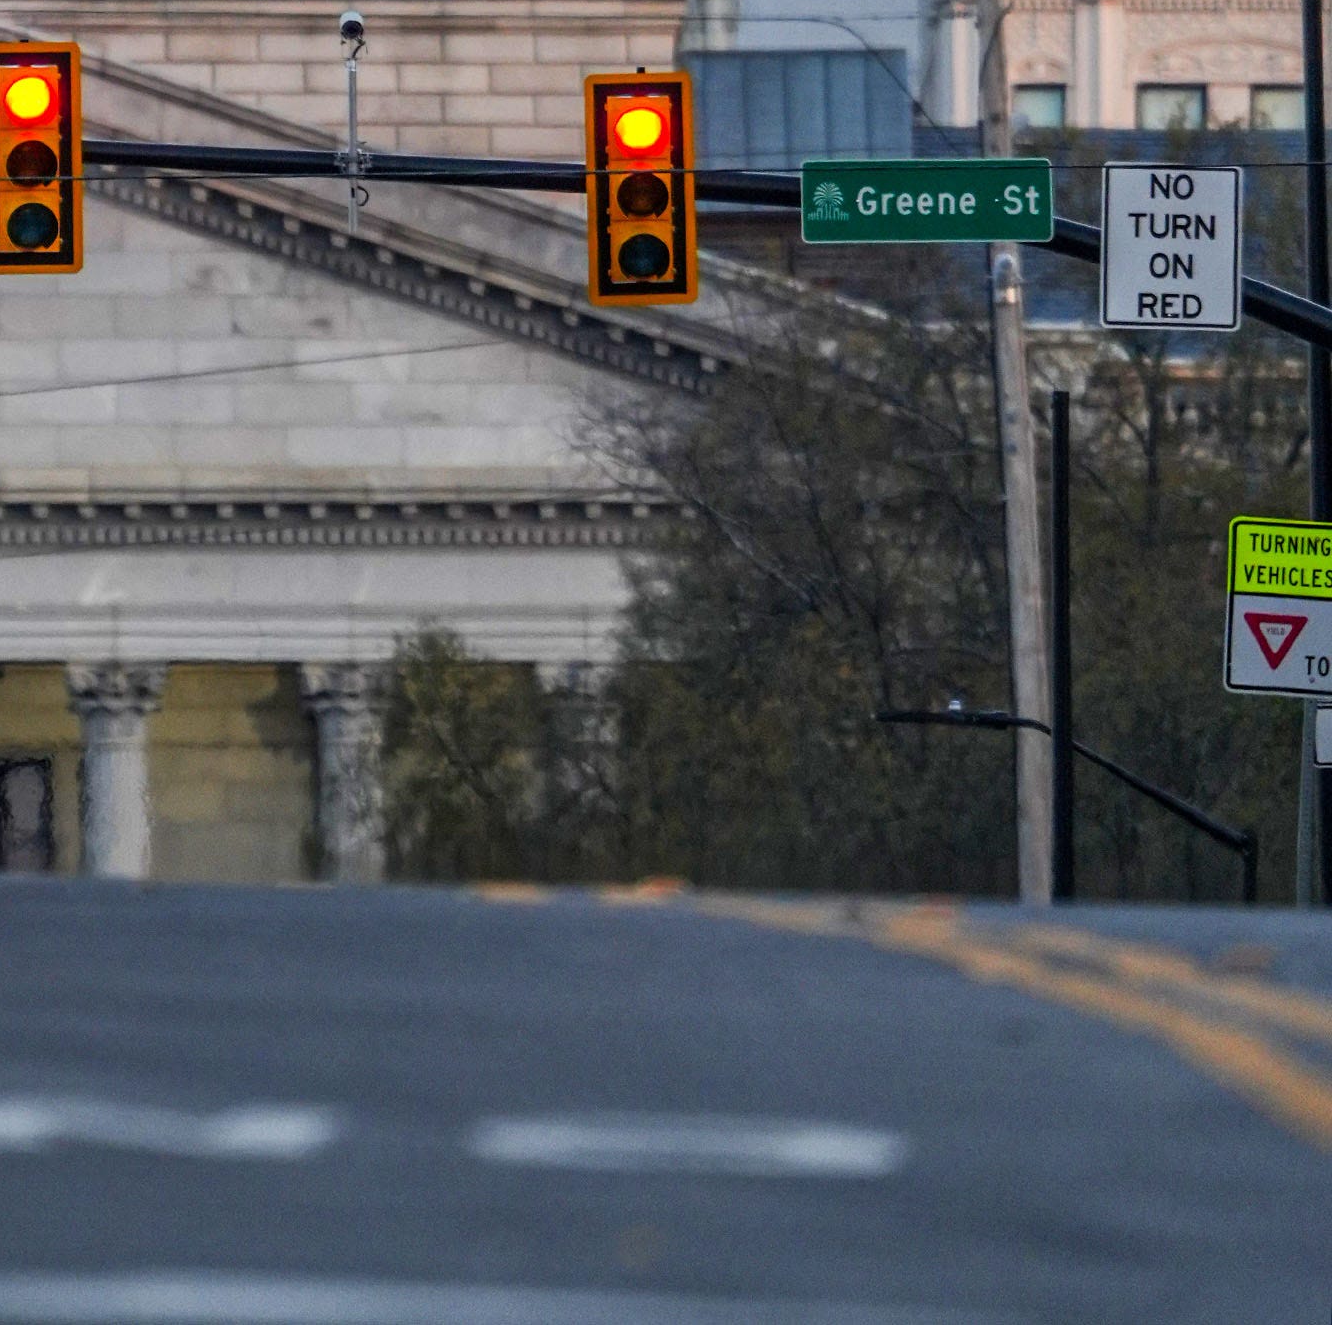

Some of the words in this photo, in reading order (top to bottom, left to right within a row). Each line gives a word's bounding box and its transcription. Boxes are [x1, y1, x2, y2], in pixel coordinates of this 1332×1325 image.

[857, 186, 977, 216] Greene
[1003, 184, 1040, 215] St
[1150, 173, 1195, 201] NO
[1128, 212, 1216, 241] TURN
[1149, 252, 1194, 280] ON
[1137, 293, 1203, 320] RED
[1250, 532, 1332, 557] TURNING
[1244, 563, 1332, 589] VEHICLES
[1266, 627, 1286, 637] YIELD
[1305, 655, 1330, 677] TO
